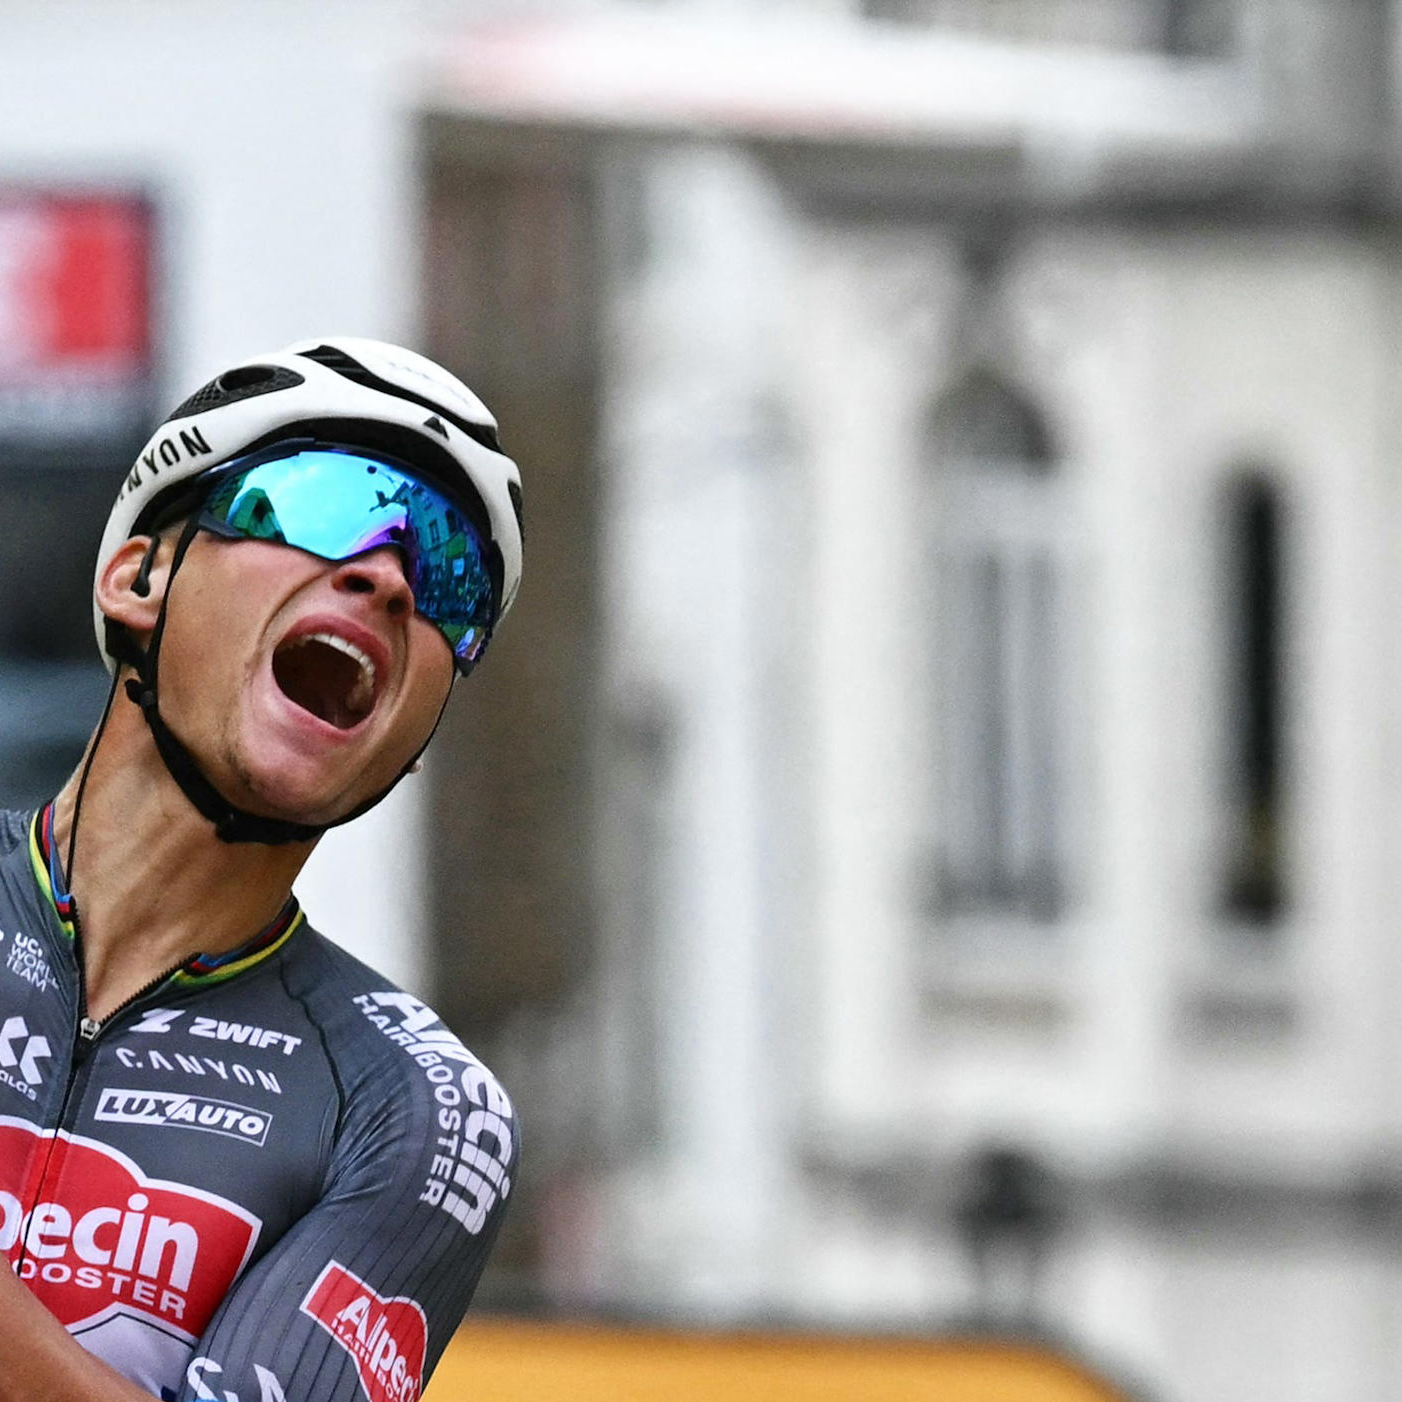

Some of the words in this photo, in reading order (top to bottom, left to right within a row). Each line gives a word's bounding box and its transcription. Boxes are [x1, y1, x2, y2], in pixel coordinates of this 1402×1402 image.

[6, 953, 46, 992] TEAM
[189, 1016, 302, 1055] ZWIFT
[116, 1047, 282, 1094] CANYON
[353, 995, 416, 1048] HAIR
[415, 1052, 462, 1206] BOOSTER
[370, 992, 513, 1235] Alpecin
[14, 1259, 187, 1320] OOSTER
